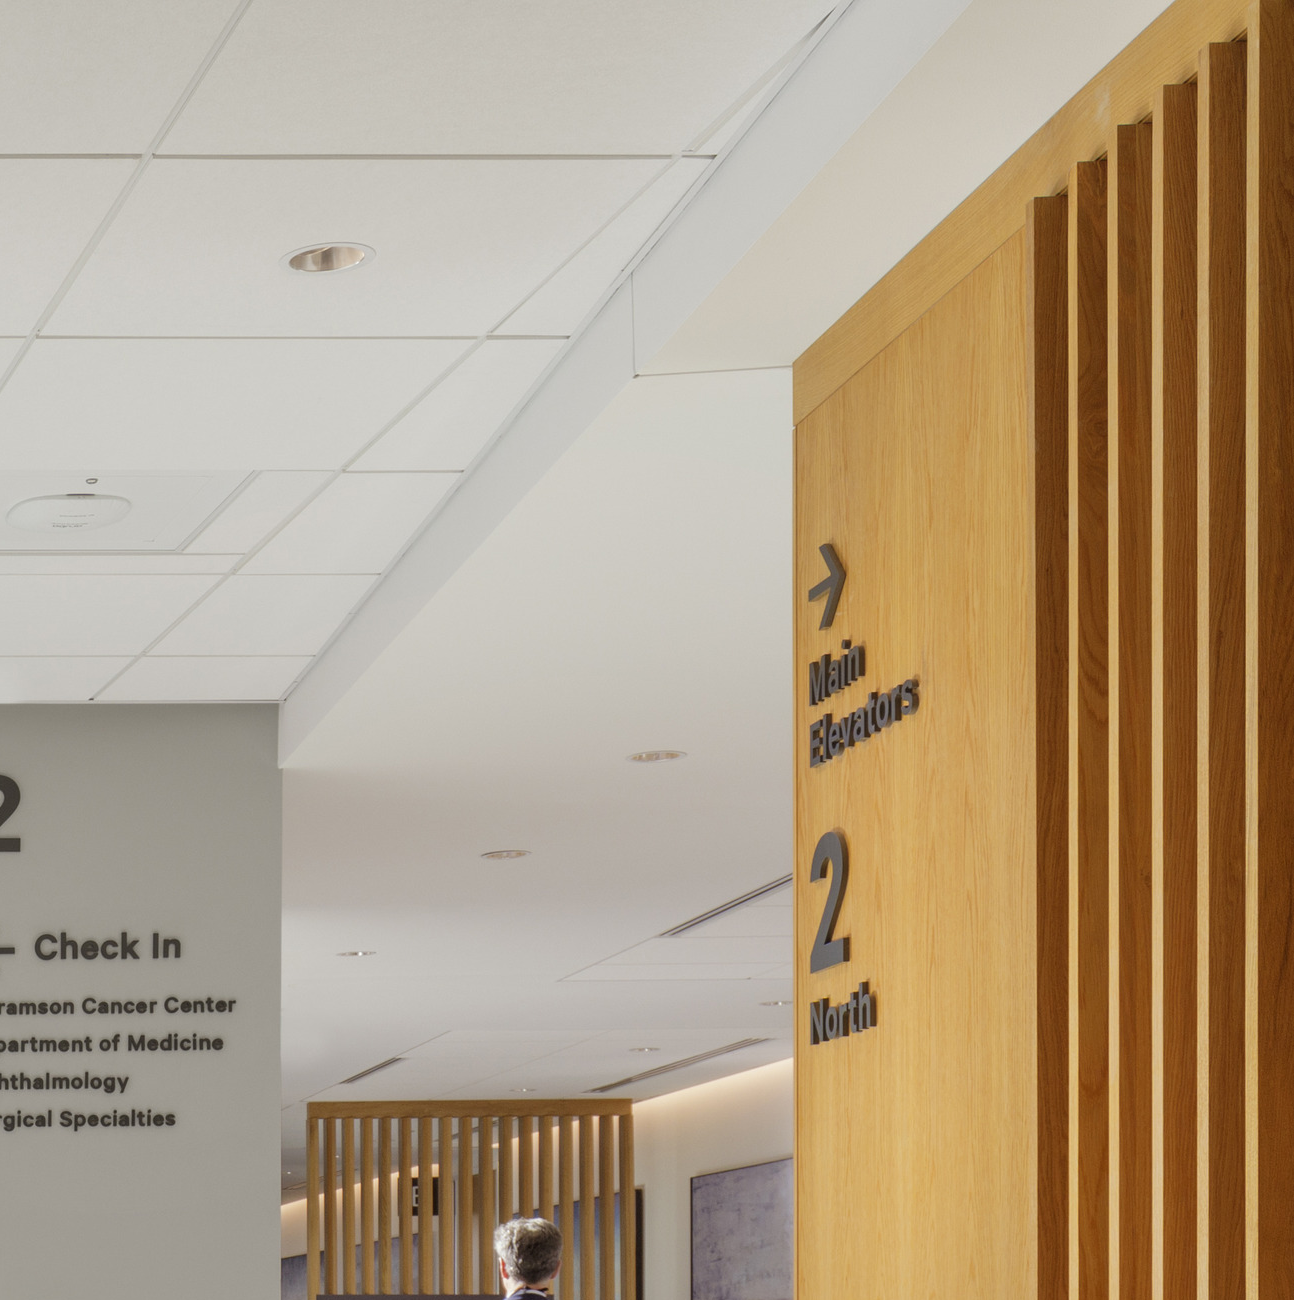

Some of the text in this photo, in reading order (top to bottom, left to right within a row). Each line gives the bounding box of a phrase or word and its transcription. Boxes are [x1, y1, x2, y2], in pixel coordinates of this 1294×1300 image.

[809, 639, 865, 706] Main
[809, 679, 919, 768] Elevators
[810, 830, 850, 973] 2
[34, 931, 182, 962] Check In
[81, 996, 158, 1015] Cancer
[163, 995, 237, 1014] Center
[810, 980, 877, 1045] North
[98, 1033, 121, 1052] of
[127, 1032, 225, 1052] Medicine
[59, 1108, 177, 1133] Specialties
